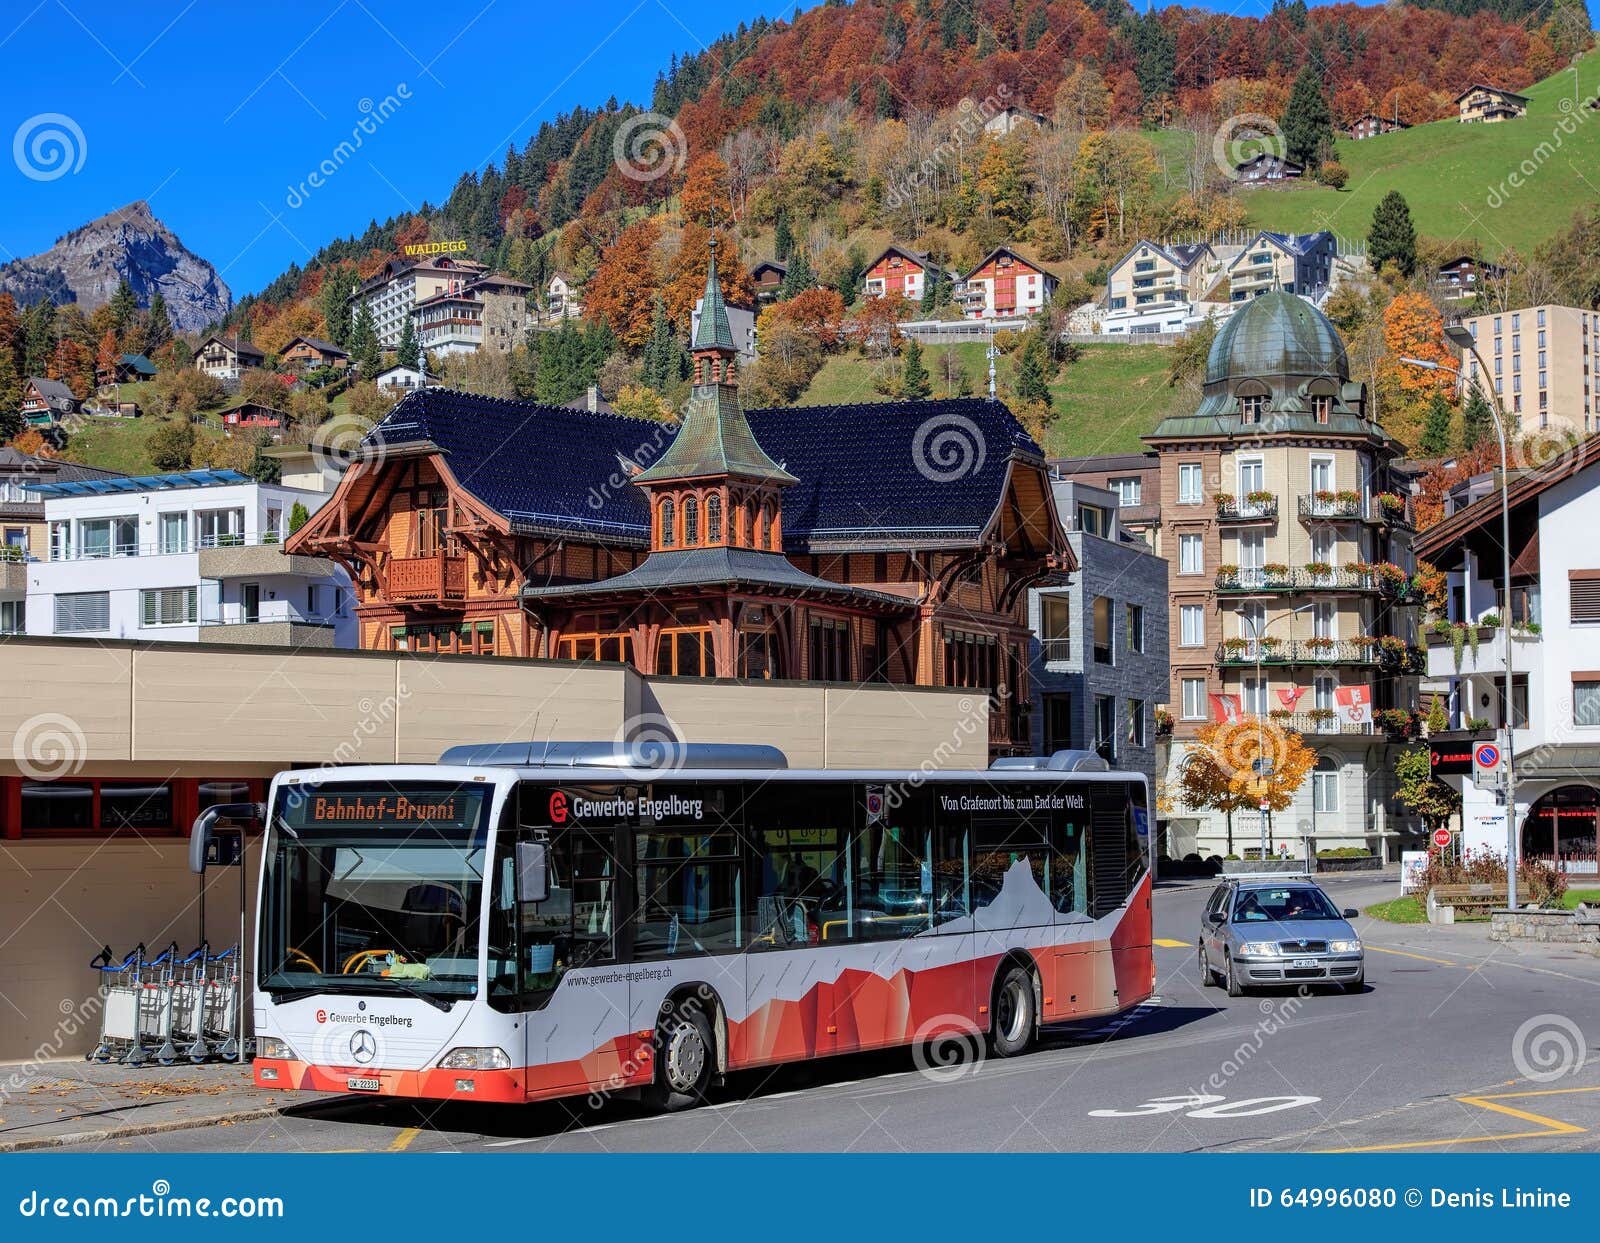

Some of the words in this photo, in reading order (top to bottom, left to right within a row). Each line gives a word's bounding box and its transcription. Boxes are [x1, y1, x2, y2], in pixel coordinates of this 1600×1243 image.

[404, 240, 467, 256] WALDEGG
[315, 797, 455, 820] Bahnhof-Brunni
[573, 796, 634, 818] Gewerbe
[638, 794, 703, 821] Engelberg
[940, 796, 959, 811] Von
[960, 795, 1002, 810] Grafenort
[1002, 795, 1015, 810] bis
[1016, 798, 1033, 809] zum
[1034, 795, 1050, 809] End
[1051, 795, 1064, 809] der
[1065, 794, 1084, 809] Welt
[1435, 834, 1449, 842] STOP
[567, 966, 672, 988] www.gewerbe-engelberg.ch
[329, 1012, 367, 1024] Gewerbe
[369, 1014, 413, 1028] Engelberg
